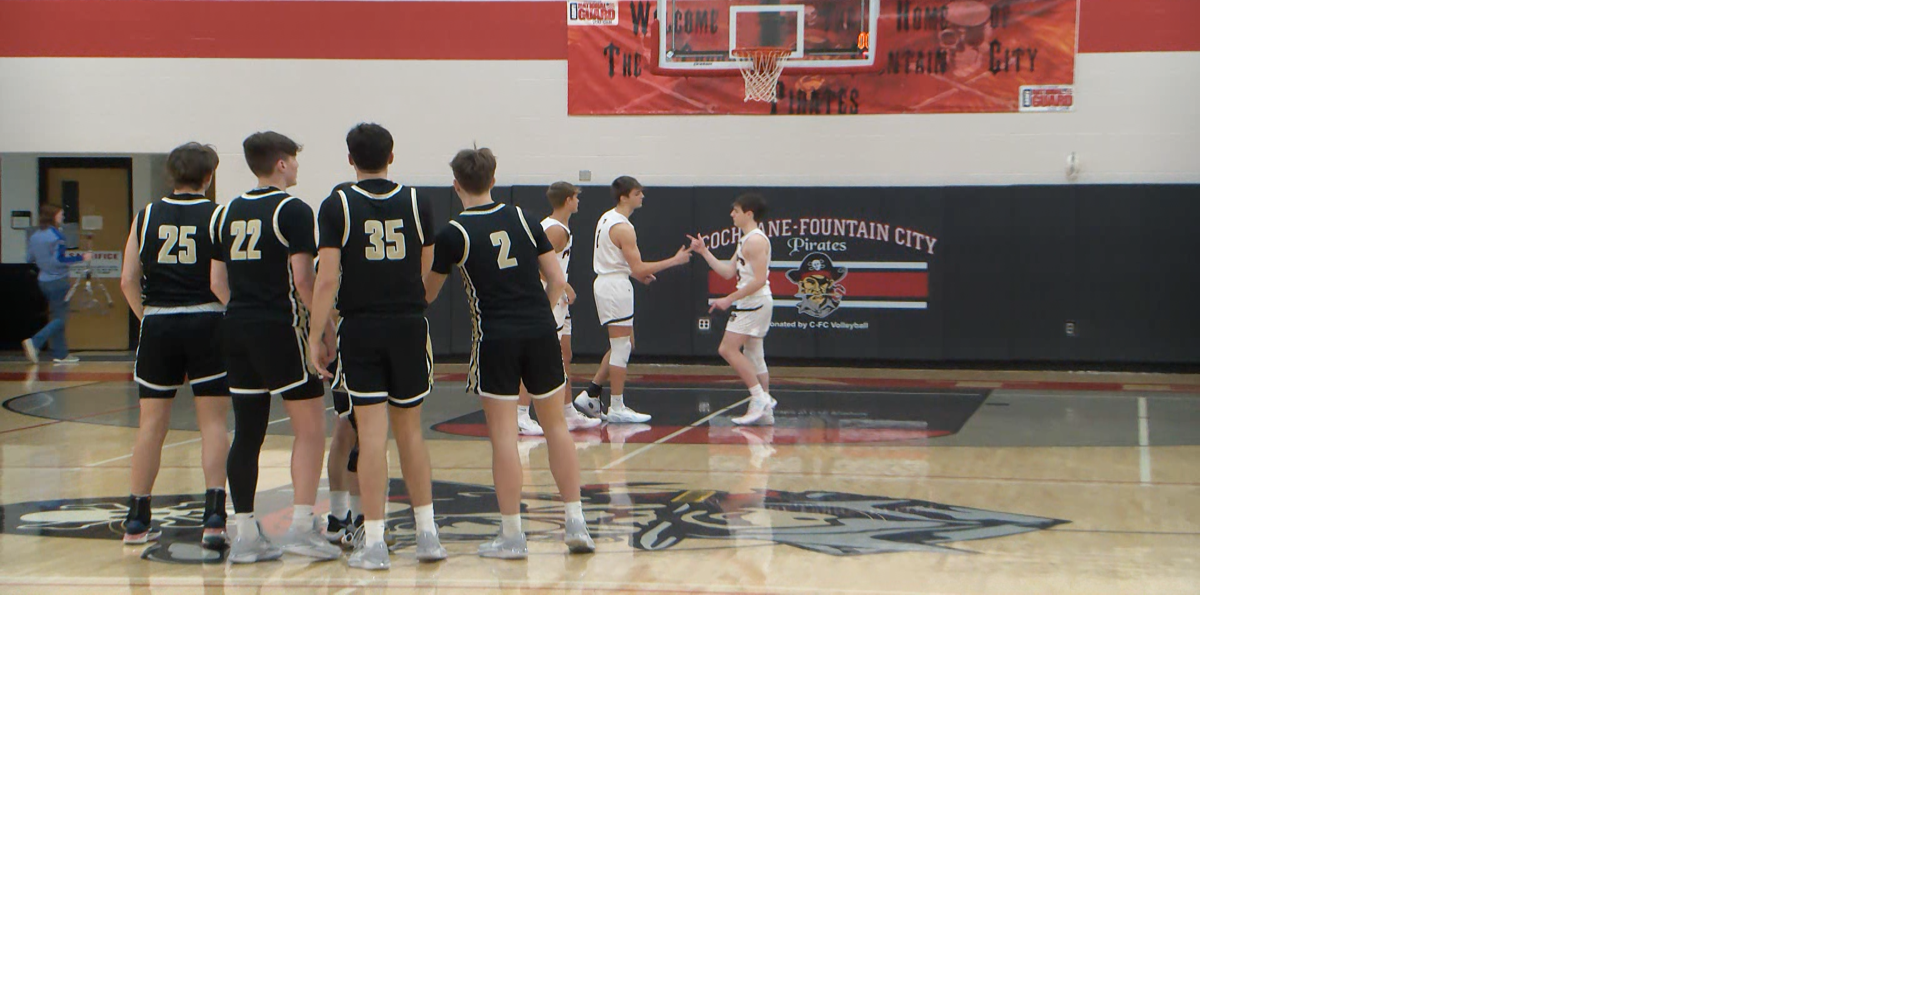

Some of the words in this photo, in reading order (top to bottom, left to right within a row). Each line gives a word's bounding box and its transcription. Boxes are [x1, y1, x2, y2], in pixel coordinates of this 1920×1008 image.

[157, 224, 197, 264] 25
[230, 219, 262, 261] 22
[364, 218, 406, 261] 35
[489, 230, 518, 270] 2
[702, 218, 890, 250] COCHANE-FOUNTAIN
[894, 226, 937, 255] CITY
[787, 237, 847, 256] Pirates
[770, 321, 796, 329] onated
[797, 321, 808, 330] by
[809, 321, 829, 329] C-FC
[831, 321, 869, 331] Volleyball
